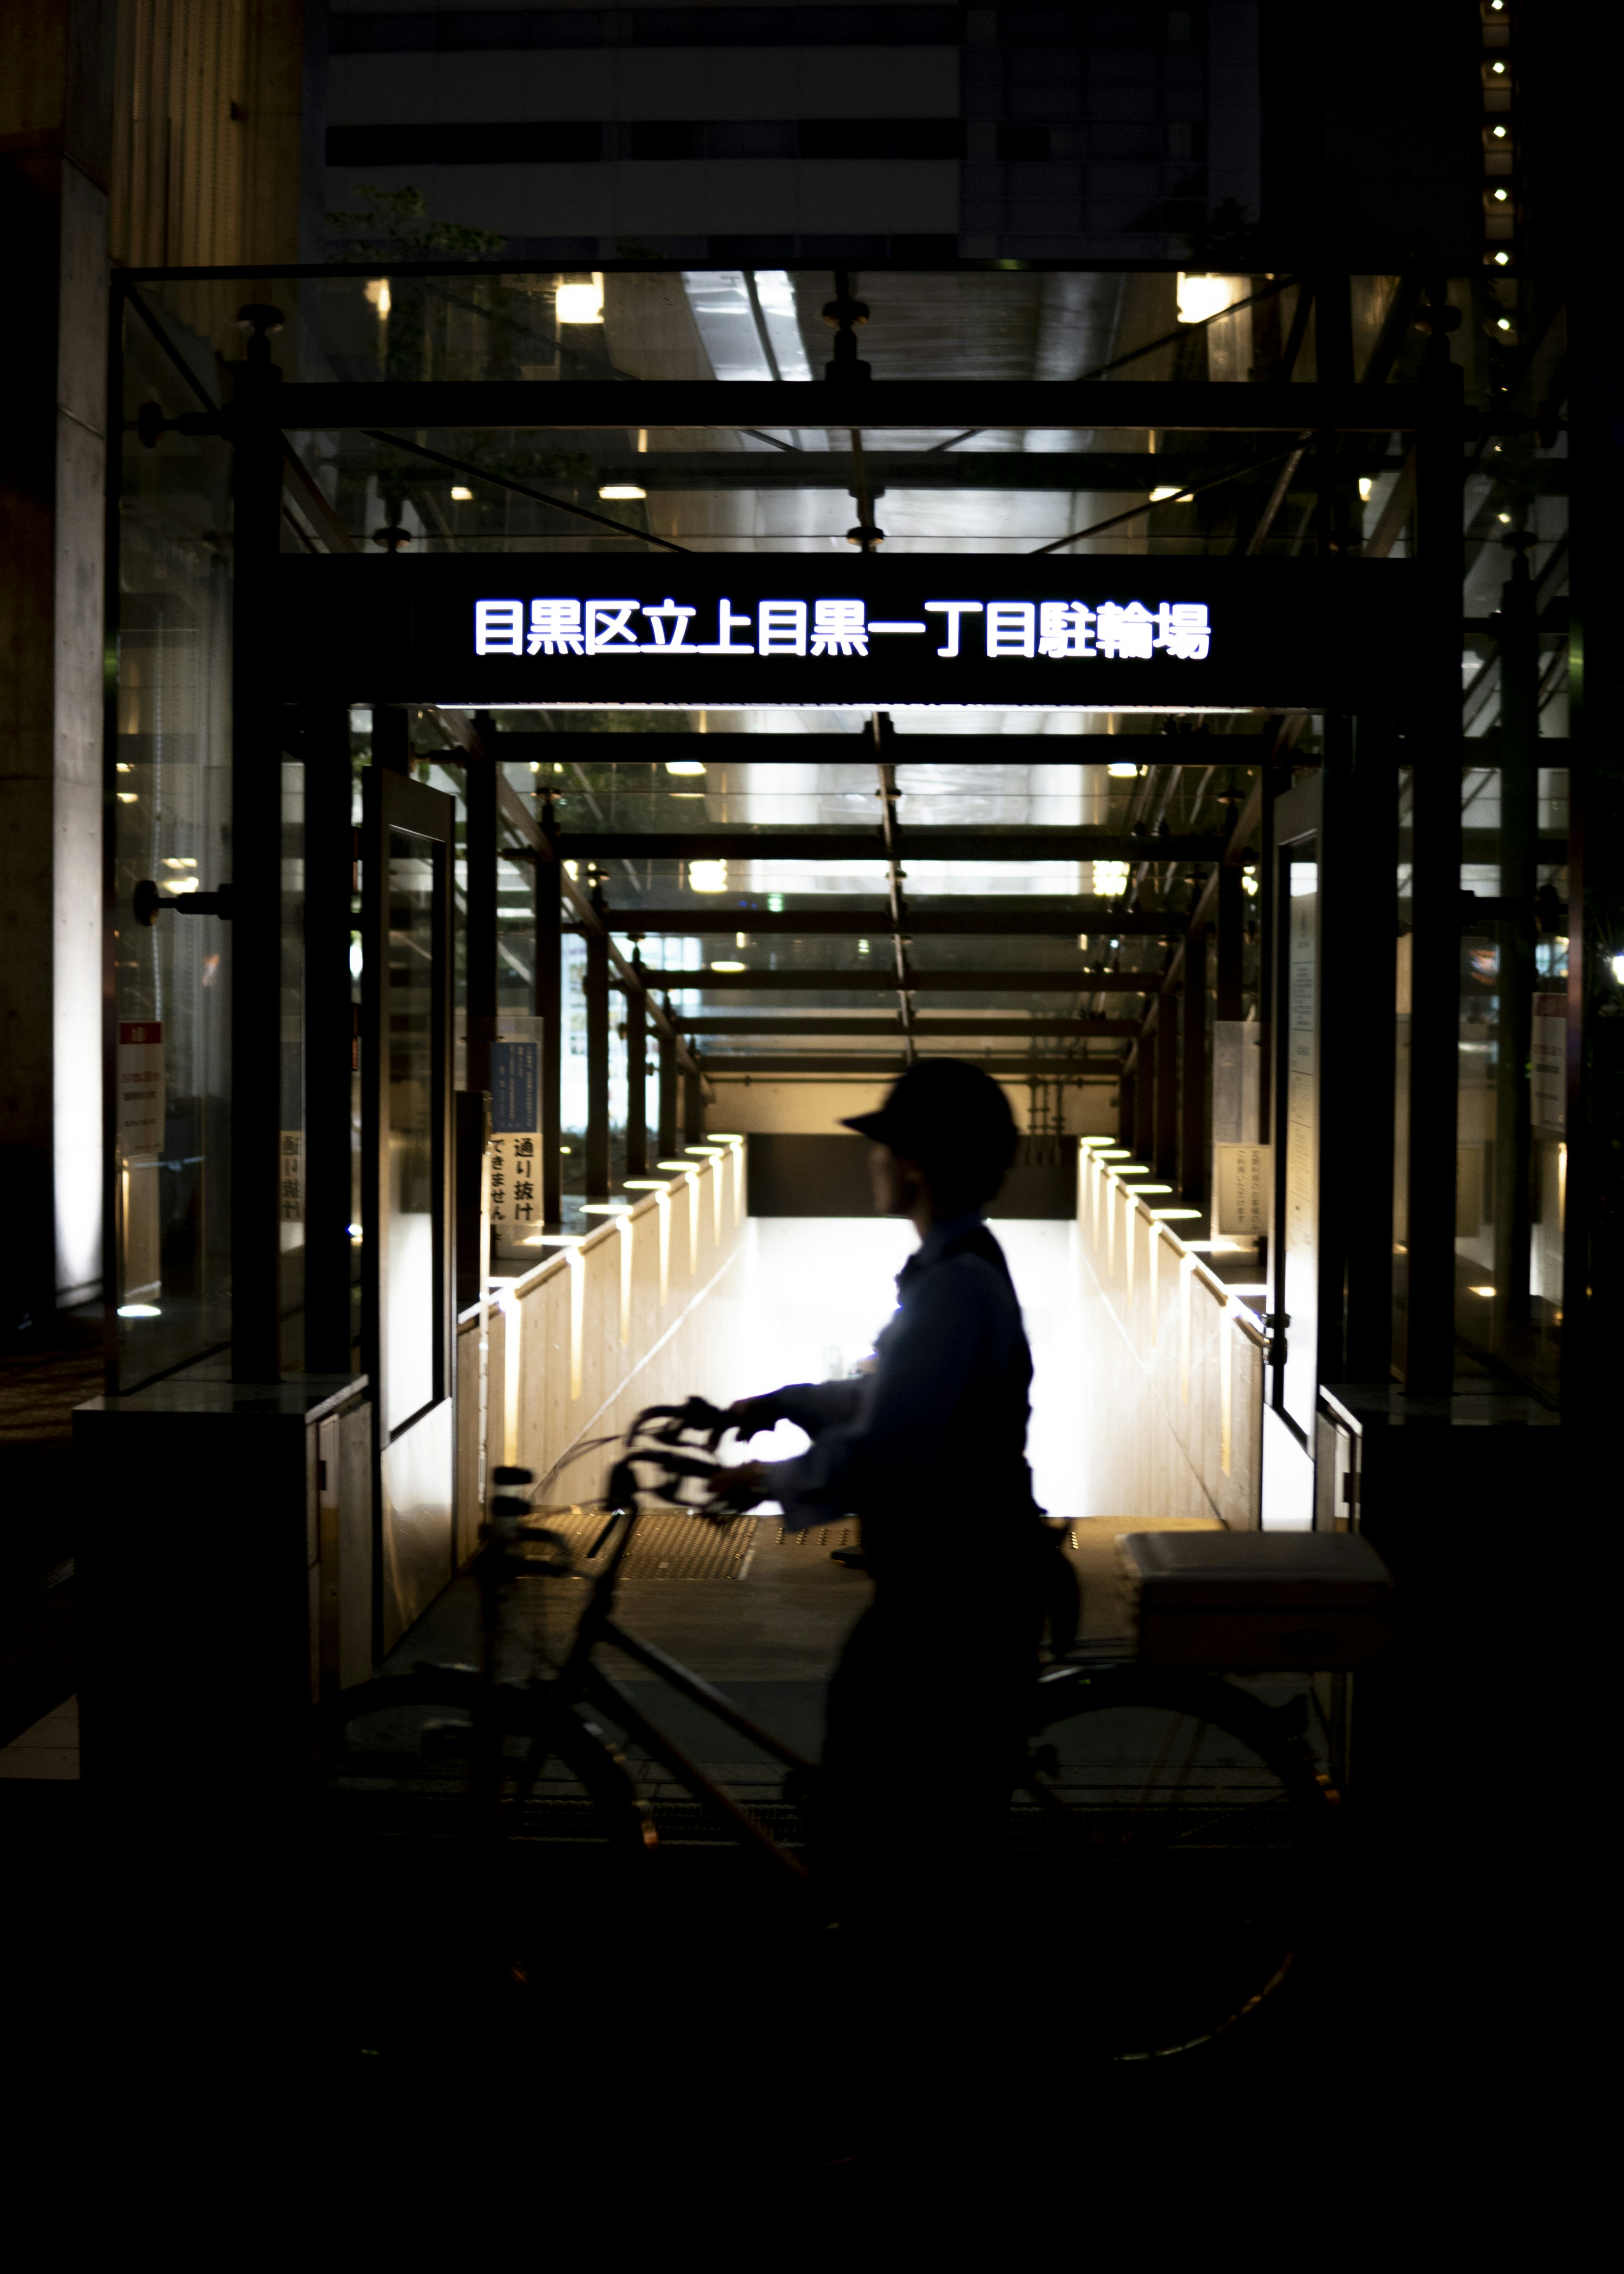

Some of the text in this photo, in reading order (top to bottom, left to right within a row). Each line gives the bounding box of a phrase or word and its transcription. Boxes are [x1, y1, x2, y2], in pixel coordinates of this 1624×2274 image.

[474, 598, 1212, 658] 目黒区立上目黒一丁目駐輪場
[513, 1138, 534, 1221] 通り抜け
